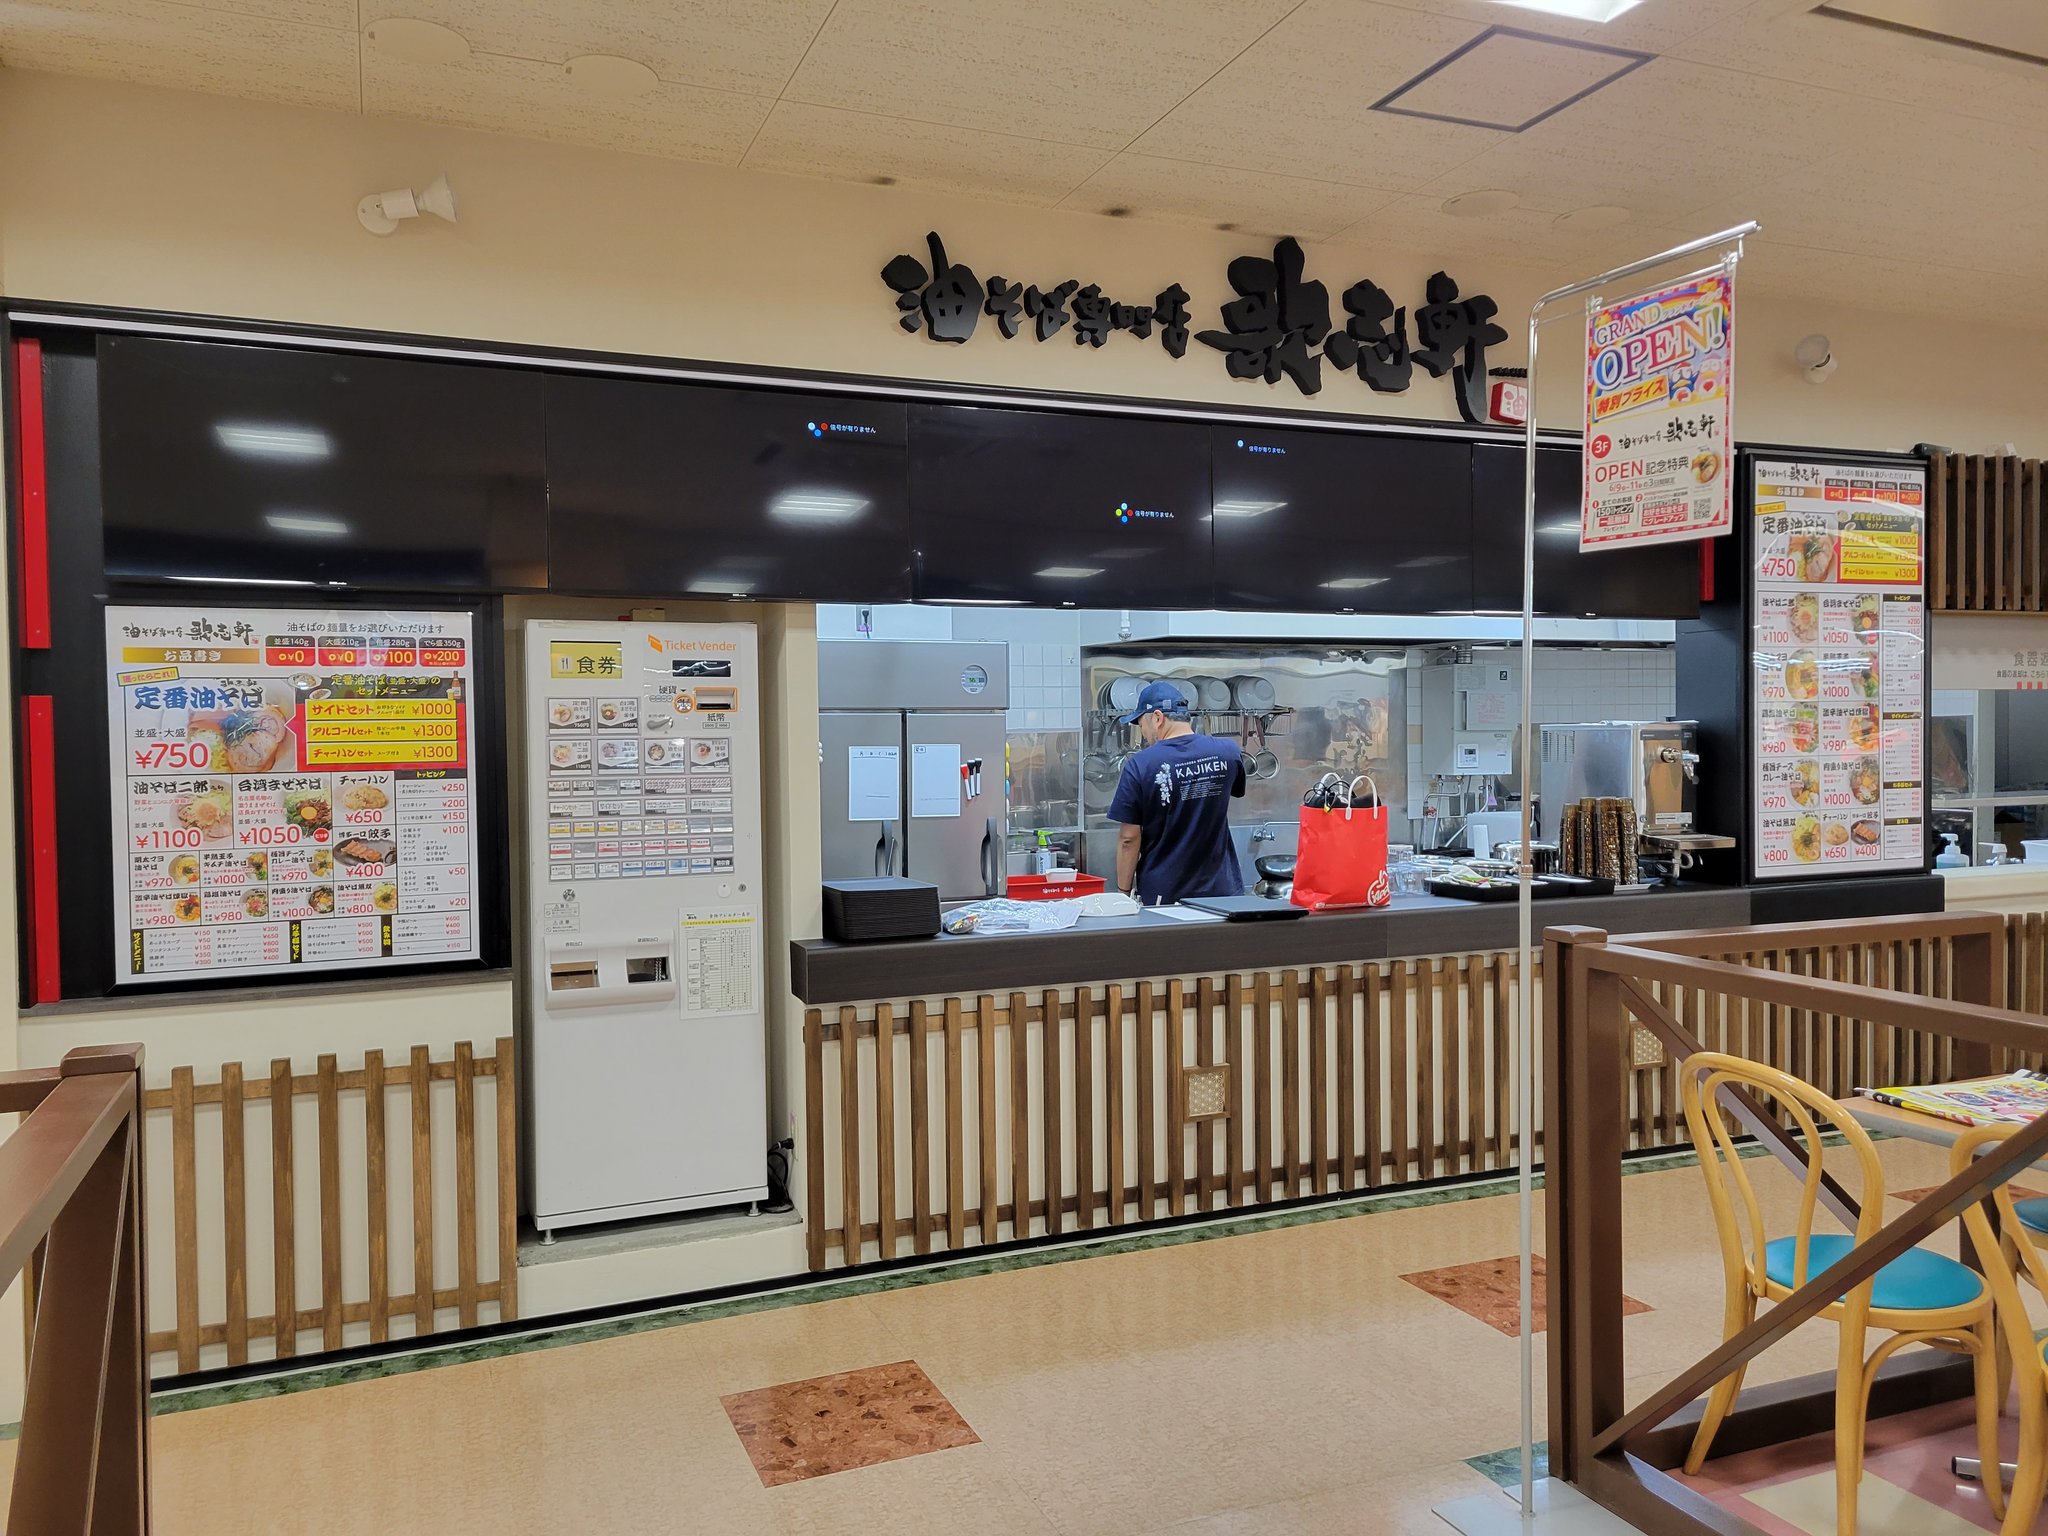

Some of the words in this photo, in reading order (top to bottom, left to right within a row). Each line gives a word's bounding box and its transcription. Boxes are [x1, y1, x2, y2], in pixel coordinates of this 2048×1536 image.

[1597, 305, 1660, 345] GRAND
[1596, 308, 1723, 388] OPEN!
[1595, 440, 1608, 454] 3F
[1595, 459, 1643, 482] OPEN
[1646, 456, 1688, 475] 記念特典
[1762, 558, 1796, 577] ¥750
[1895, 568, 1916, 578] ¥1300
[274, 638, 310, 646] 並盛140g
[326, 638, 360, 647] 大盛210g
[1763, 632, 1789, 643] ¥1100
[1823, 632, 1849, 643] ¥1050
[424, 639, 461, 648] でら盛350g
[664, 640, 696, 651] Ticket
[699, 641, 737, 652] Vender
[164, 650, 221, 662] お品書き
[576, 656, 616, 675] 食券
[356, 687, 418, 696] セットメニュー
[658, 685, 677, 694] 硬貨
[1763, 686, 1785, 697] ¥970
[1823, 686, 1850, 697] ¥1000
[134, 686, 263, 710] 定番油そば
[311, 703, 374, 716] サイドセット
[412, 703, 452, 715] ¥1000
[707, 713, 726, 722] 紙幣
[135, 728, 186, 738] 並盛・大盛
[312, 726, 373, 736] アルコールセット
[413, 724, 453, 737] ¥1300
[1763, 742, 1786, 752] ¥980
[1823, 740, 1847, 752] ¥980
[135, 742, 209, 769] ¥750
[313, 749, 373, 759] チャーハンセット
[413, 746, 454, 759] ¥1300
[416, 770, 446, 778] トッピング
[1175, 760, 1228, 779] KAJIKEN
[238, 778, 321, 792] 台湾まぜそば
[339, 775, 389, 785] チャーハン
[134, 780, 208, 794] 油そば二郎
[442, 783, 465, 791] ¥250
[442, 799, 465, 808] ¥200
[1763, 796, 1786, 808] ¥970
[1824, 793, 1851, 805] ¥1000
[346, 810, 383, 824] ¥650
[442, 812, 465, 820] ¥150
[240, 826, 300, 844] ¥1050
[442, 826, 465, 834] ¥100
[136, 829, 201, 848] ¥1100
[1764, 850, 1788, 861] ¥800
[1825, 846, 1847, 858] ¥650
[1855, 844, 1877, 856] ¥400
[271, 857, 313, 865] カレー油そば
[346, 864, 383, 877] ¥400
[449, 867, 466, 875] ¥50
[213, 875, 245, 884] ¥1000
[281, 872, 308, 881] ¥970
[145, 878, 173, 887] ¥970
[449, 897, 467, 906] ¥20
[282, 907, 313, 917] ¥1000
[346, 904, 373, 914] ¥800
[145, 915, 175, 925] ¥980
[214, 911, 242, 921] ¥980
